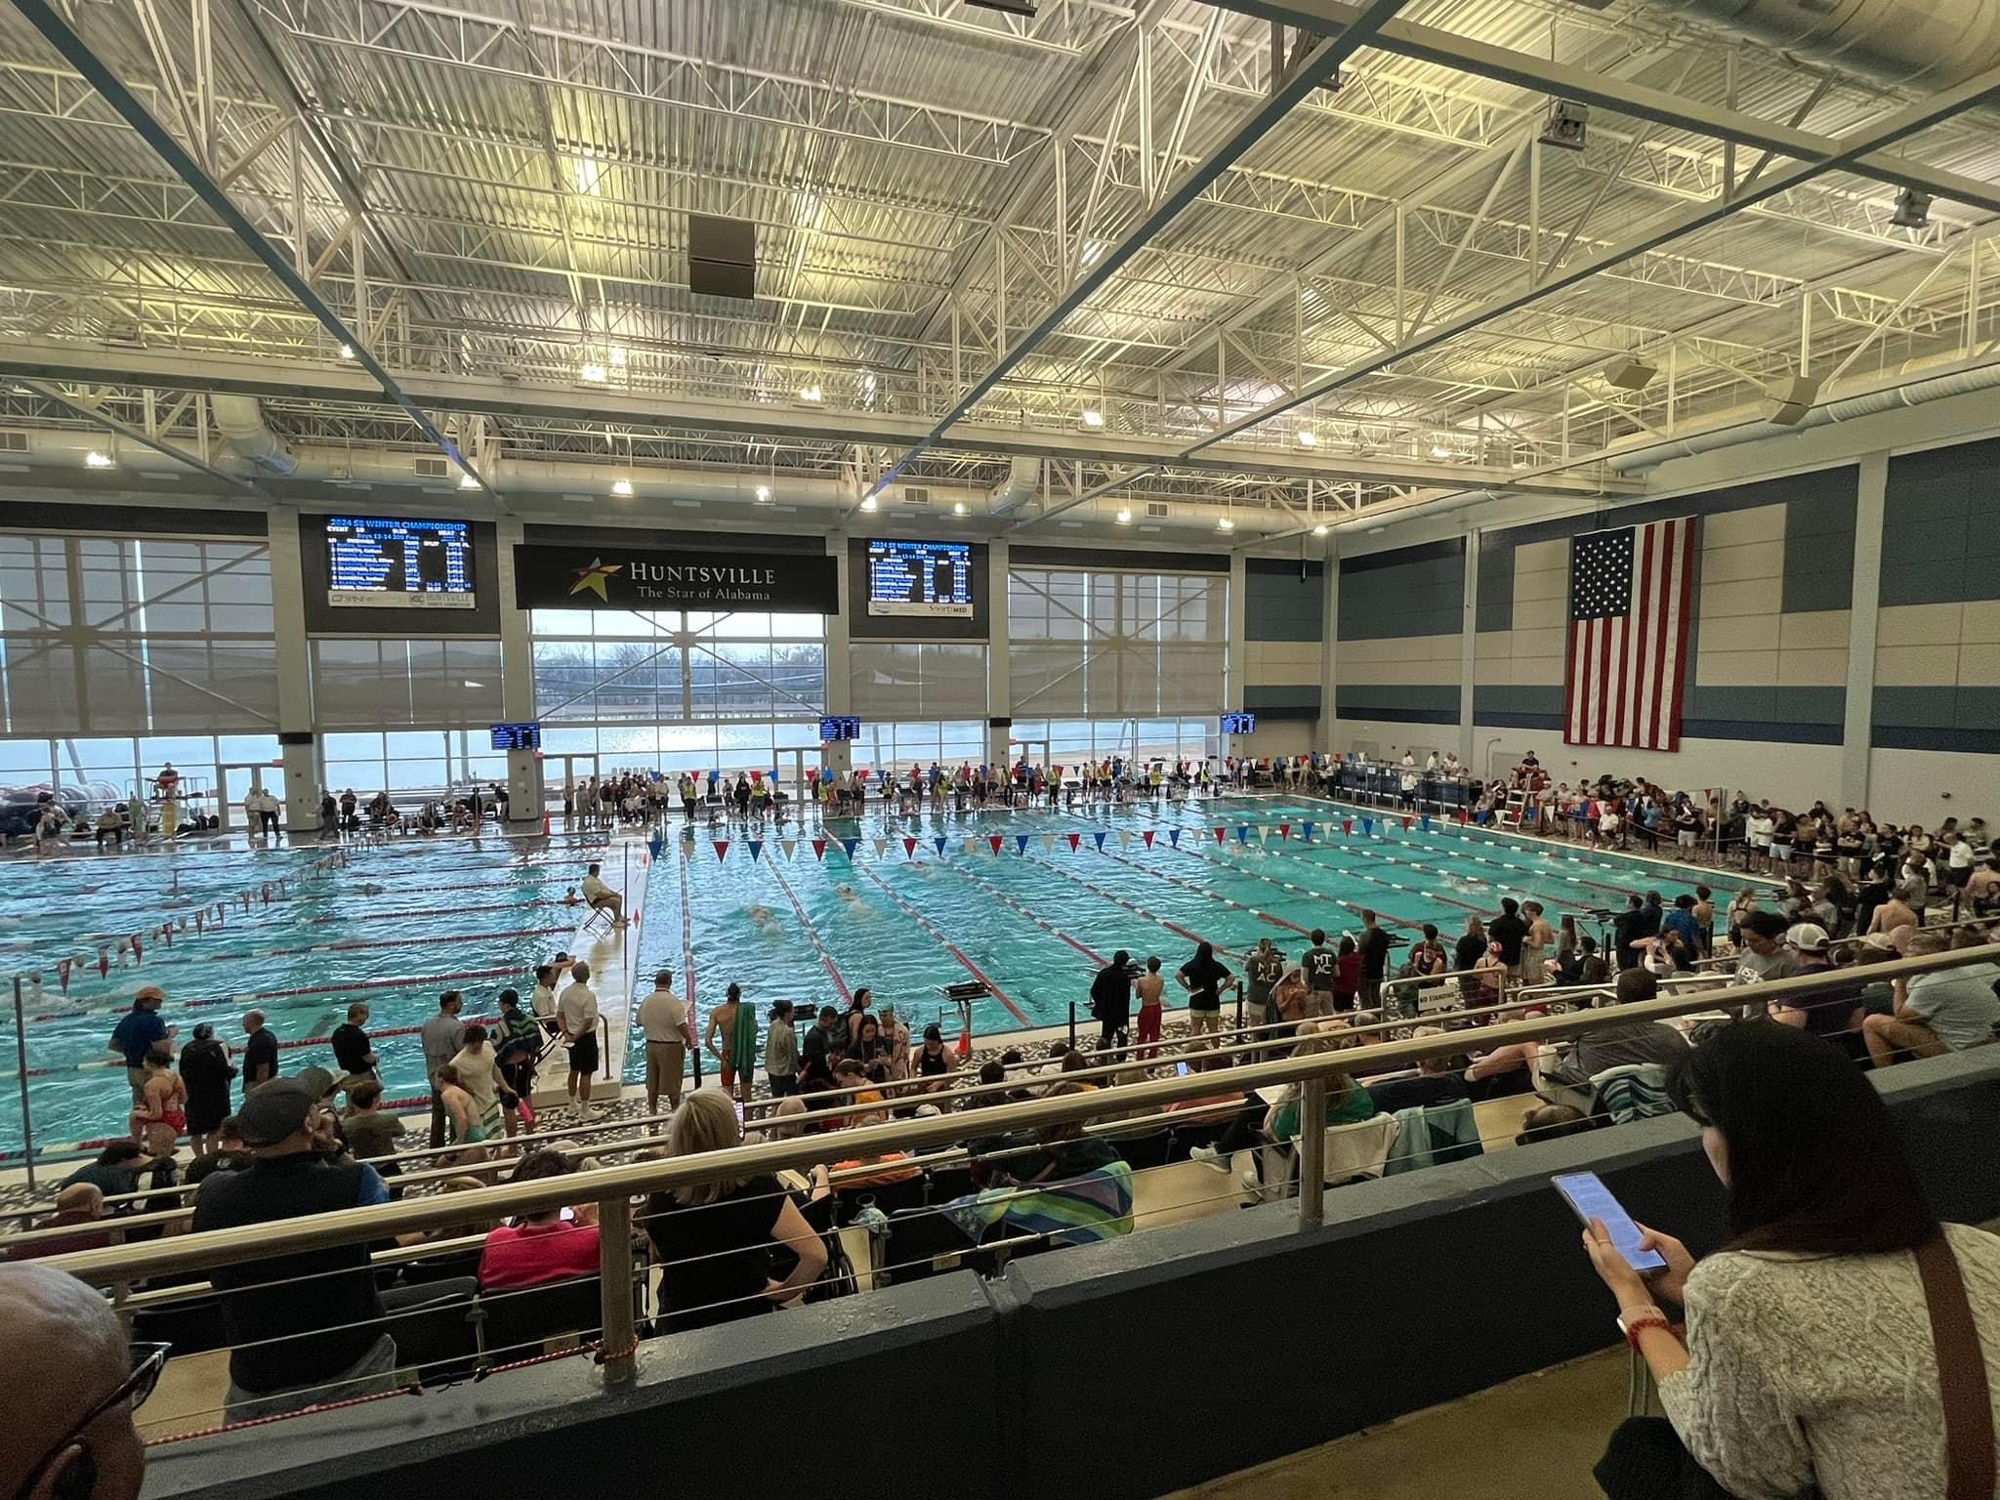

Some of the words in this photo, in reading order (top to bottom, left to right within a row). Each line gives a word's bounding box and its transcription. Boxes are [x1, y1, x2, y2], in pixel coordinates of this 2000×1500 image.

[330, 518, 352, 527] 2024
[366, 519, 401, 528] WINTER
[401, 521, 466, 531] CHAMPIONSHIP
[630, 562, 776, 585] HUNTSVILLE
[637, 585, 663, 599] The
[667, 586, 695, 600] Star
[698, 587, 712, 600] of
[714, 588, 770, 601] Alabama
[1312, 953, 1332, 965] MT
[1315, 964, 1332, 974] AC
[1256, 973, 1277, 983] AC
